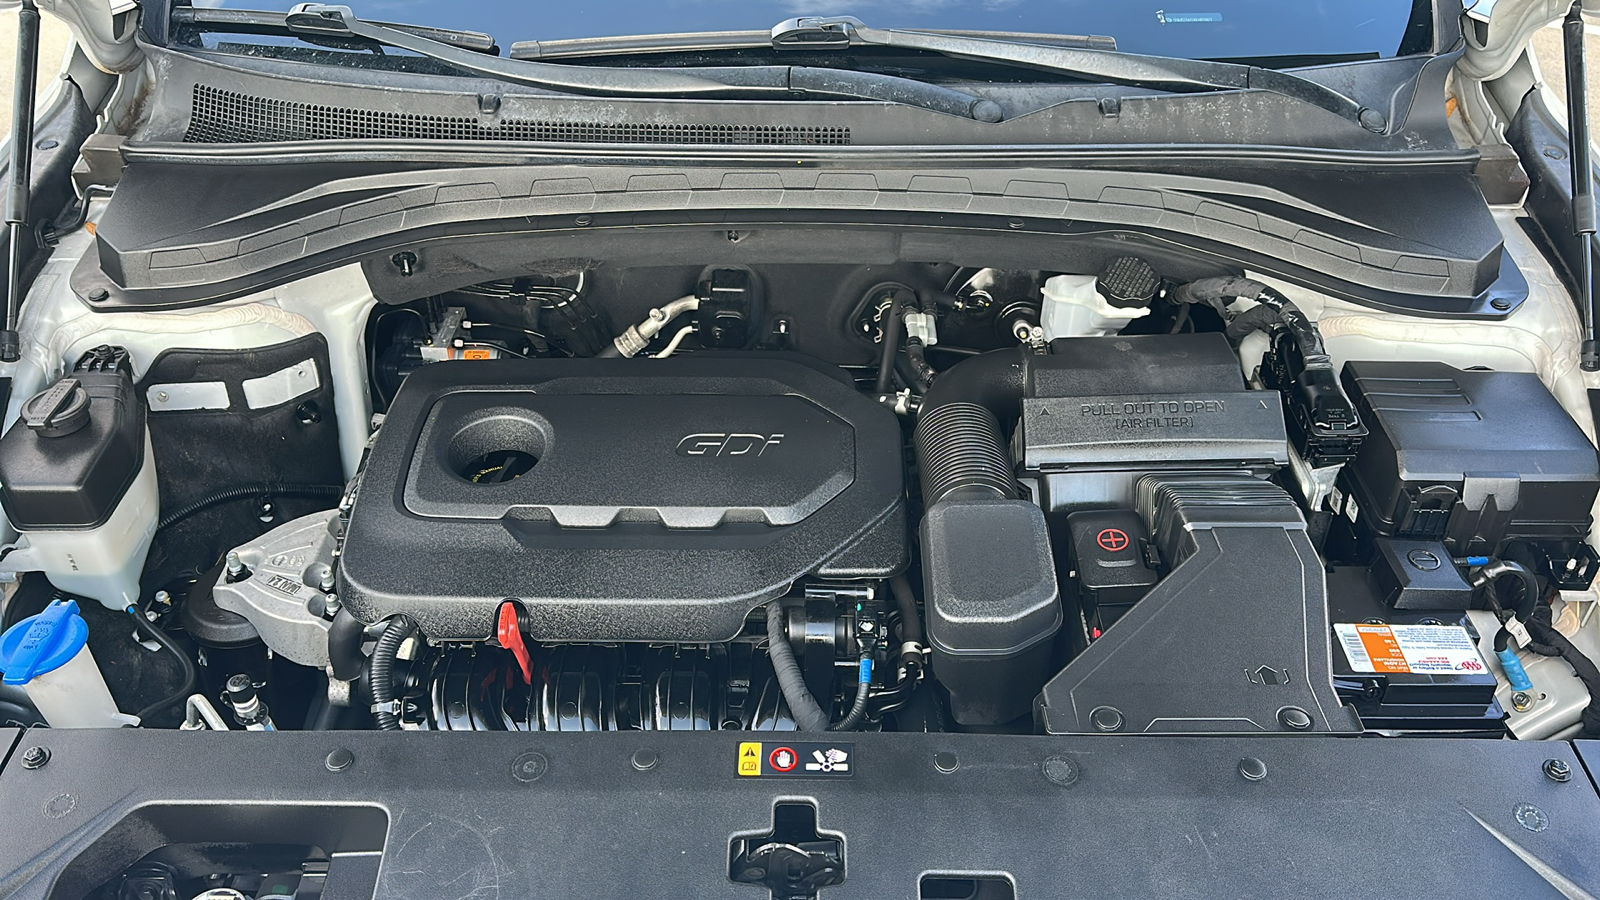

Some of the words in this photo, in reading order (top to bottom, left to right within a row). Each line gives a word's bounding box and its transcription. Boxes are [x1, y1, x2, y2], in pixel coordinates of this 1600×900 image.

[1081, 404, 1122, 417] PULL
[1124, 402, 1156, 415] OUT
[1158, 401, 1180, 414] TO
[1183, 400, 1226, 413] OPEN
[675, 433, 785, 457] GDi
[1461, 660, 1482, 671] AAA
